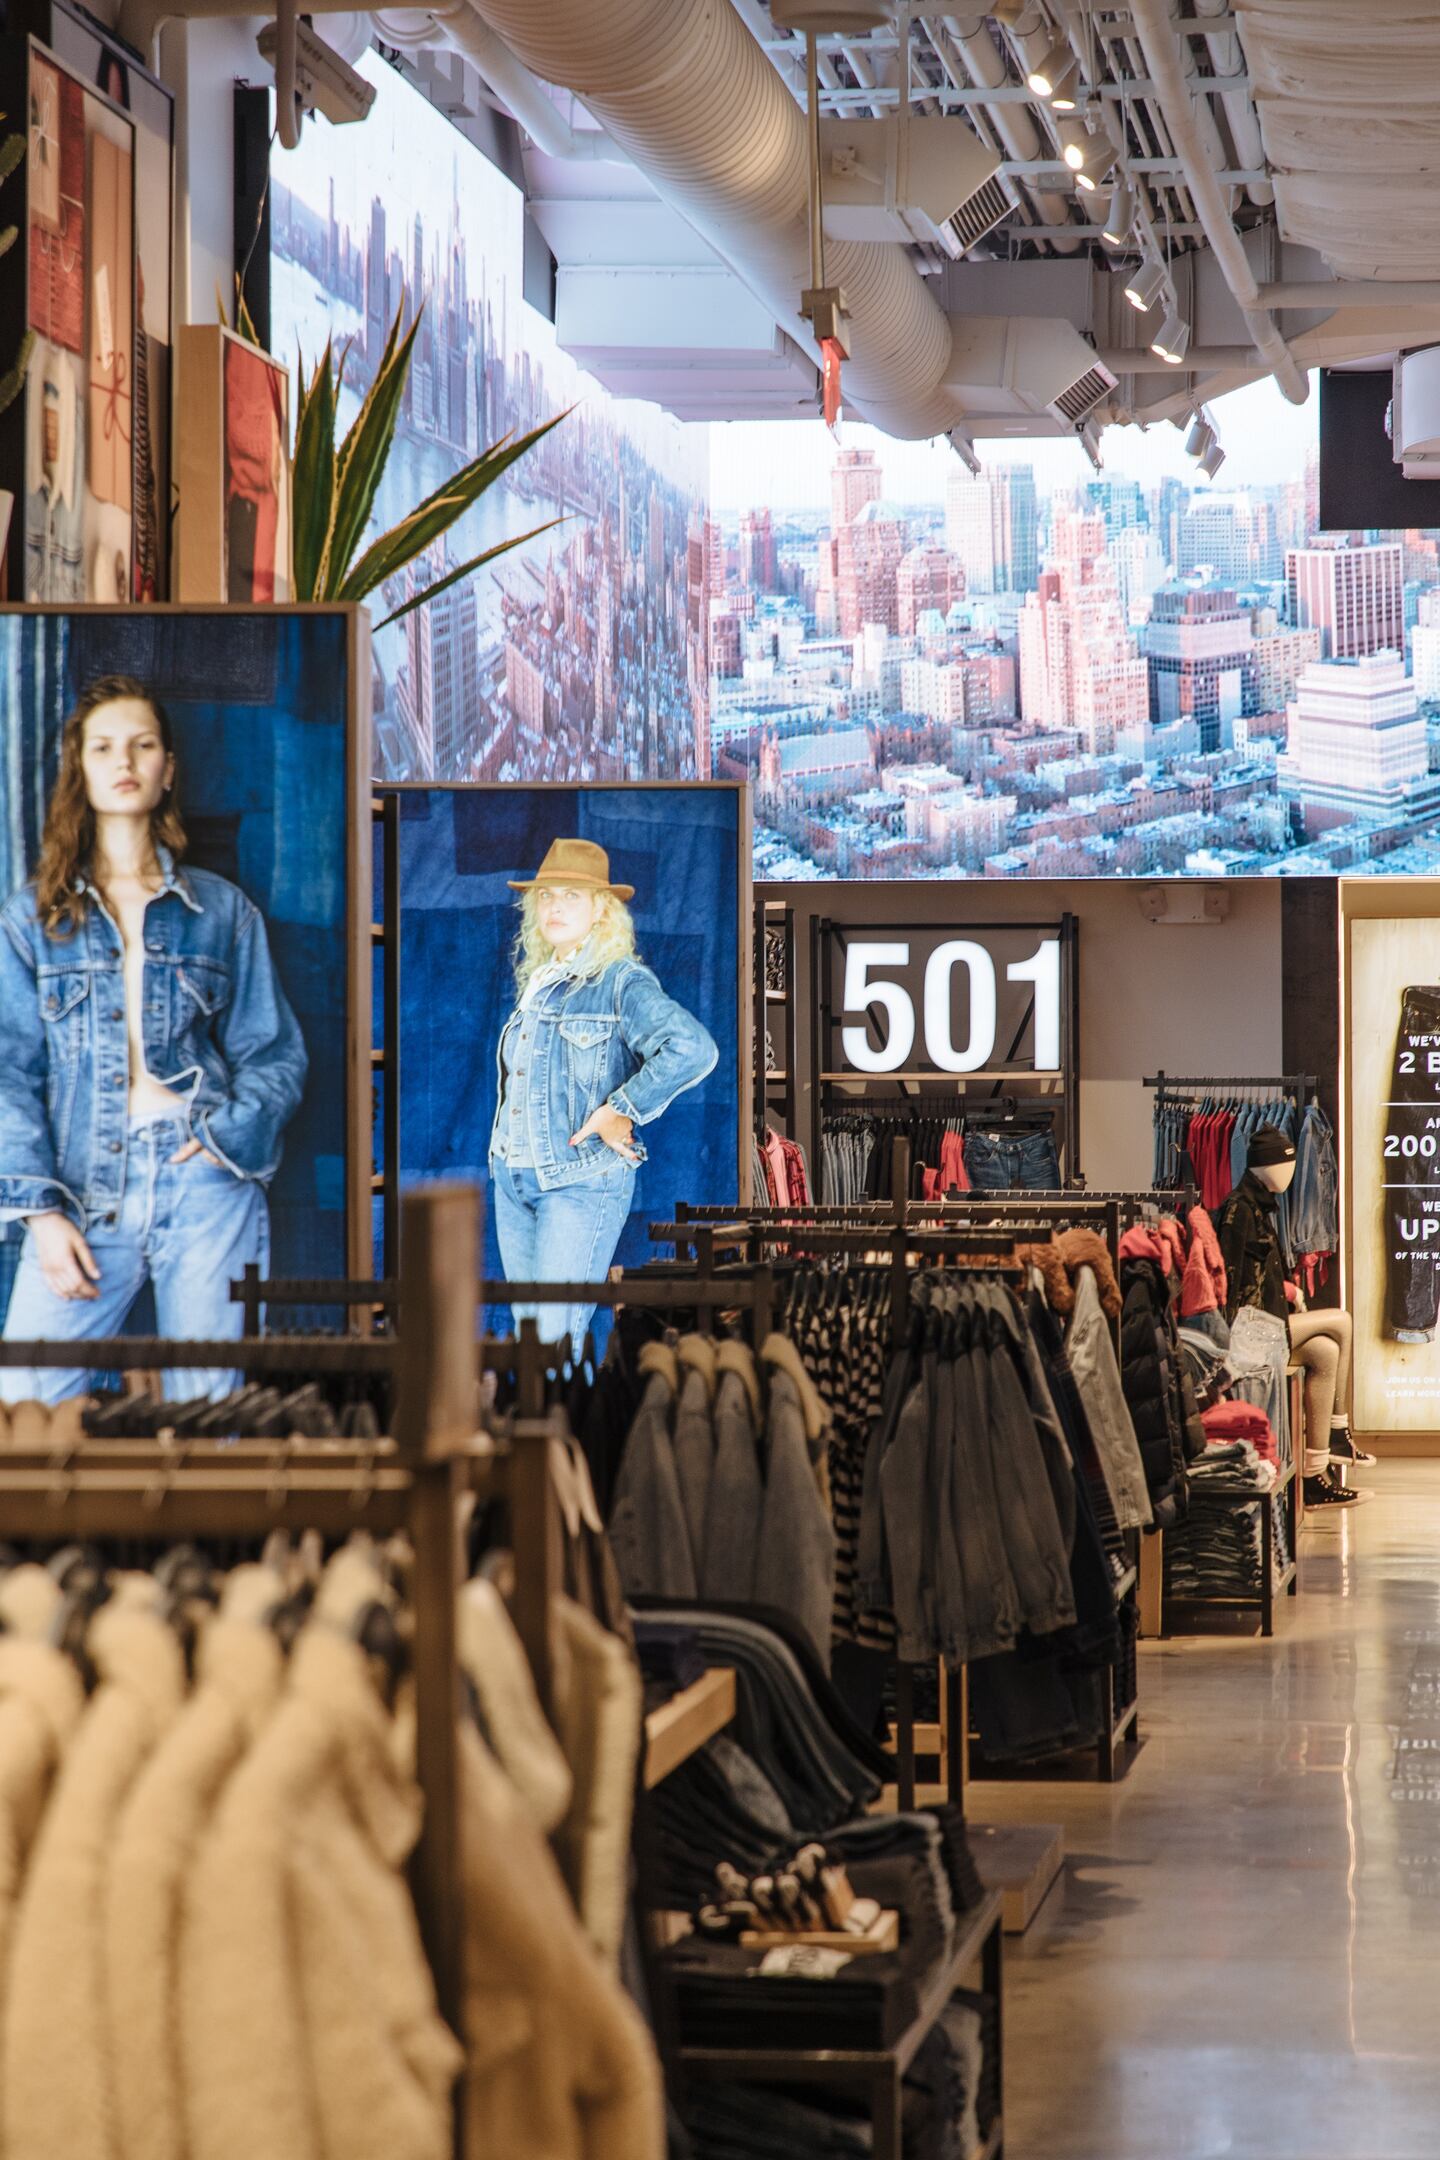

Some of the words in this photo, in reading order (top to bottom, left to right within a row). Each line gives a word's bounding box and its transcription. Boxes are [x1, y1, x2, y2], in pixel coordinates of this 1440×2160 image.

[842, 940, 1060, 1073] 501
[1398, 1051, 1416, 1073] 2
[1383, 1134, 1437, 1157] 200
[1400, 1218, 1440, 1241] UP
[1395, 1251, 1409, 1260] OF
[1410, 1251, 1430, 1260] THE
